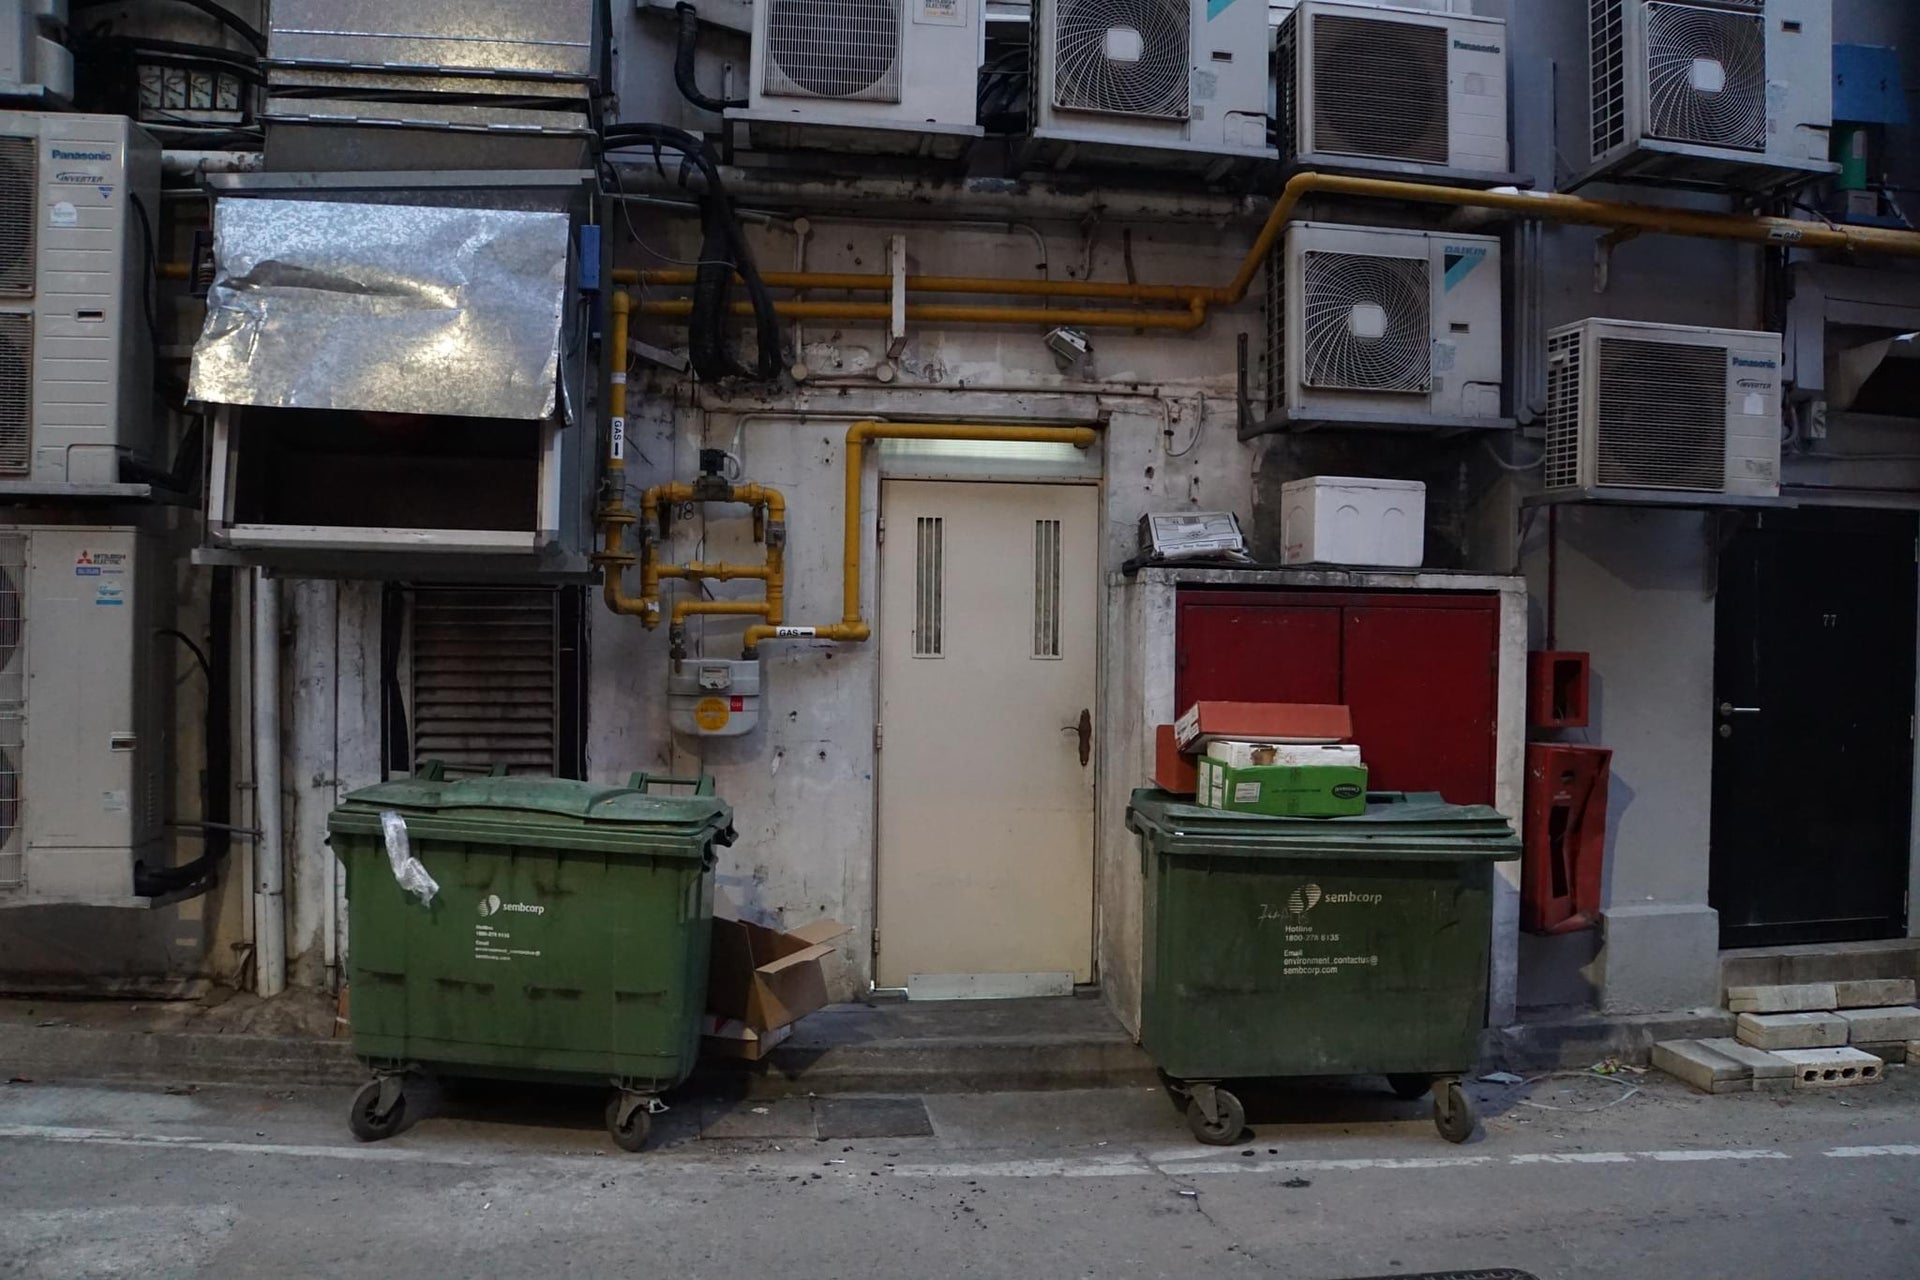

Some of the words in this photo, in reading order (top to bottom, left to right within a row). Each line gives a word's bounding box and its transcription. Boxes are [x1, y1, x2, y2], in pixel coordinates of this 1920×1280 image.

[1453, 40, 1500, 53] Panasonic
[52, 149, 112, 160] Panasonic
[1783, 230, 1801, 240] GAS
[1732, 356, 1776, 368] Panasonic
[614, 420, 623, 441] GAS
[1823, 614, 1837, 628] 77
[779, 629, 799, 637] GAS
[1325, 891, 1382, 904] sembcorp
[503, 903, 545, 915] sembcorp
[1285, 925, 1313, 933] Hotline
[1284, 949, 1303, 957] Email
[1283, 966, 1338, 976] sembcorp.com
